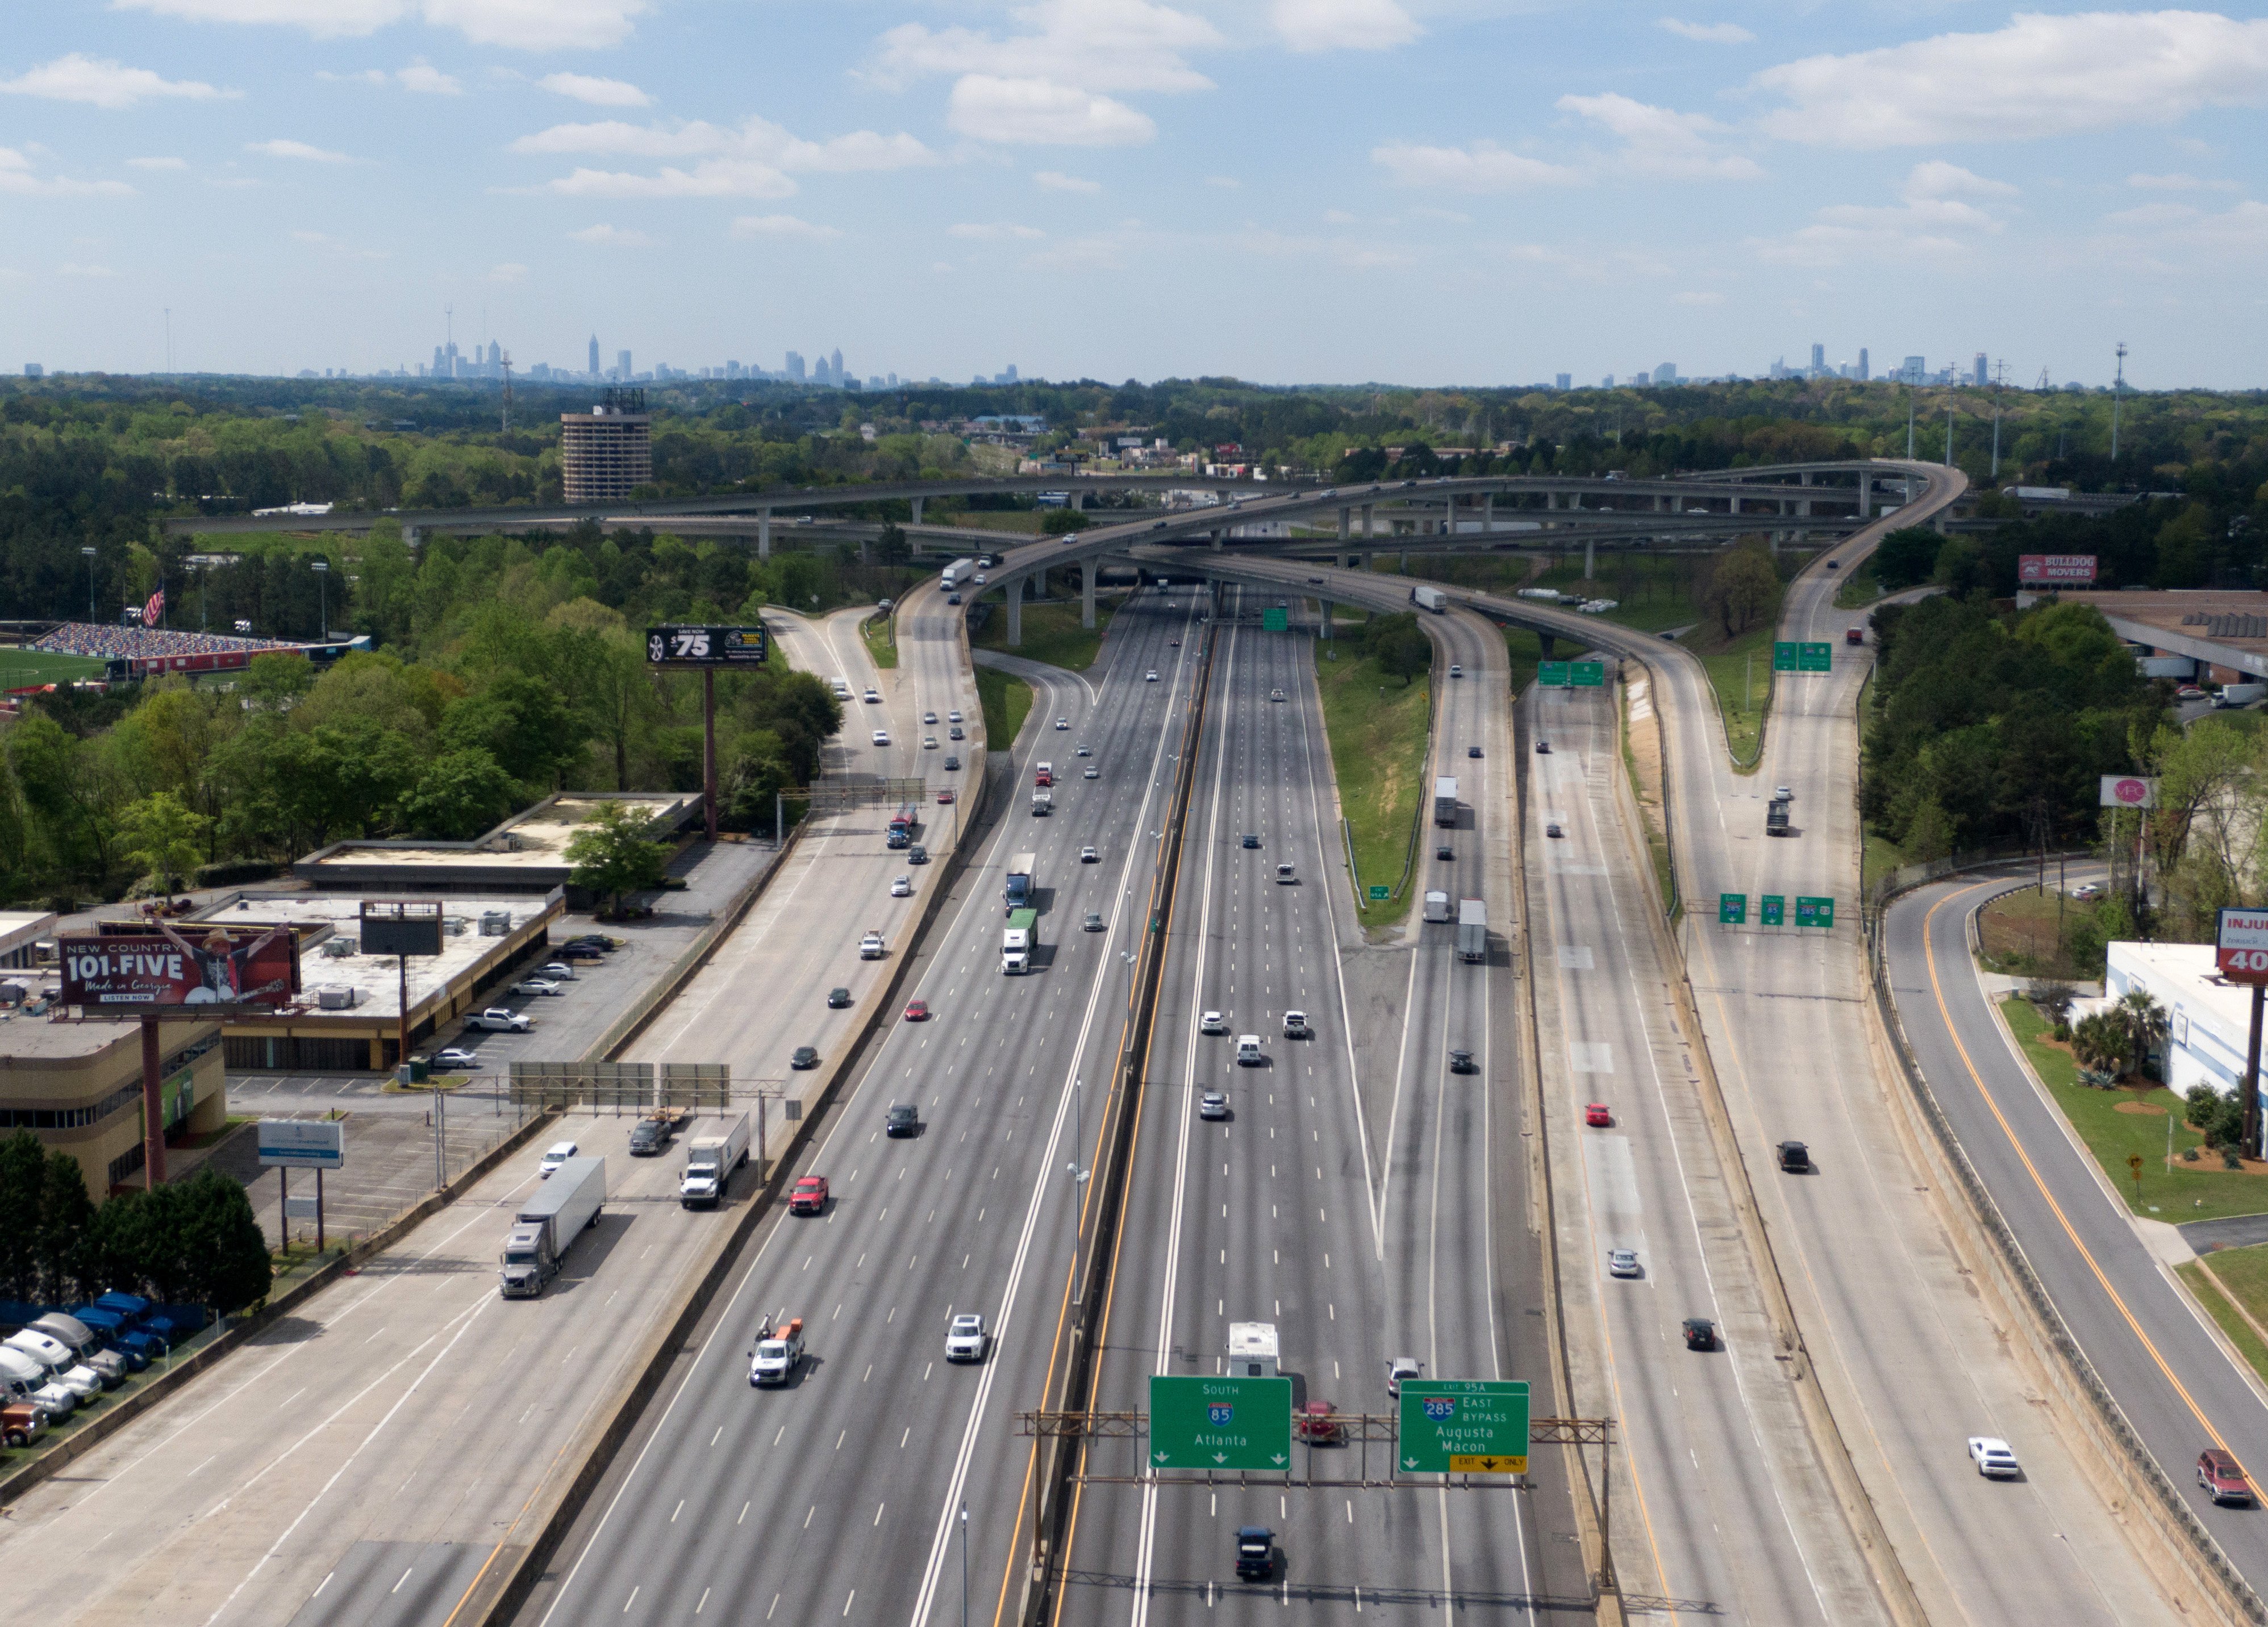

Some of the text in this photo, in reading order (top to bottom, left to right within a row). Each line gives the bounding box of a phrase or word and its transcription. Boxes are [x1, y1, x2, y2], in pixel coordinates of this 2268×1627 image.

[2045, 557, 2094, 566] BULLDOG
[85, 979, 113, 991] Made
[131, 980, 172, 995] Georgia
[1465, 1383, 1486, 1392] 95A
[1211, 1409, 1229, 1421] 85
[1427, 1403, 1453, 1415] 285
[1463, 1413, 1507, 1422] BYPASS
[1436, 1426, 1494, 1440] Augusta
[1195, 1434, 1246, 1446] Atlanta
[1442, 1440, 1485, 1453] Macon
